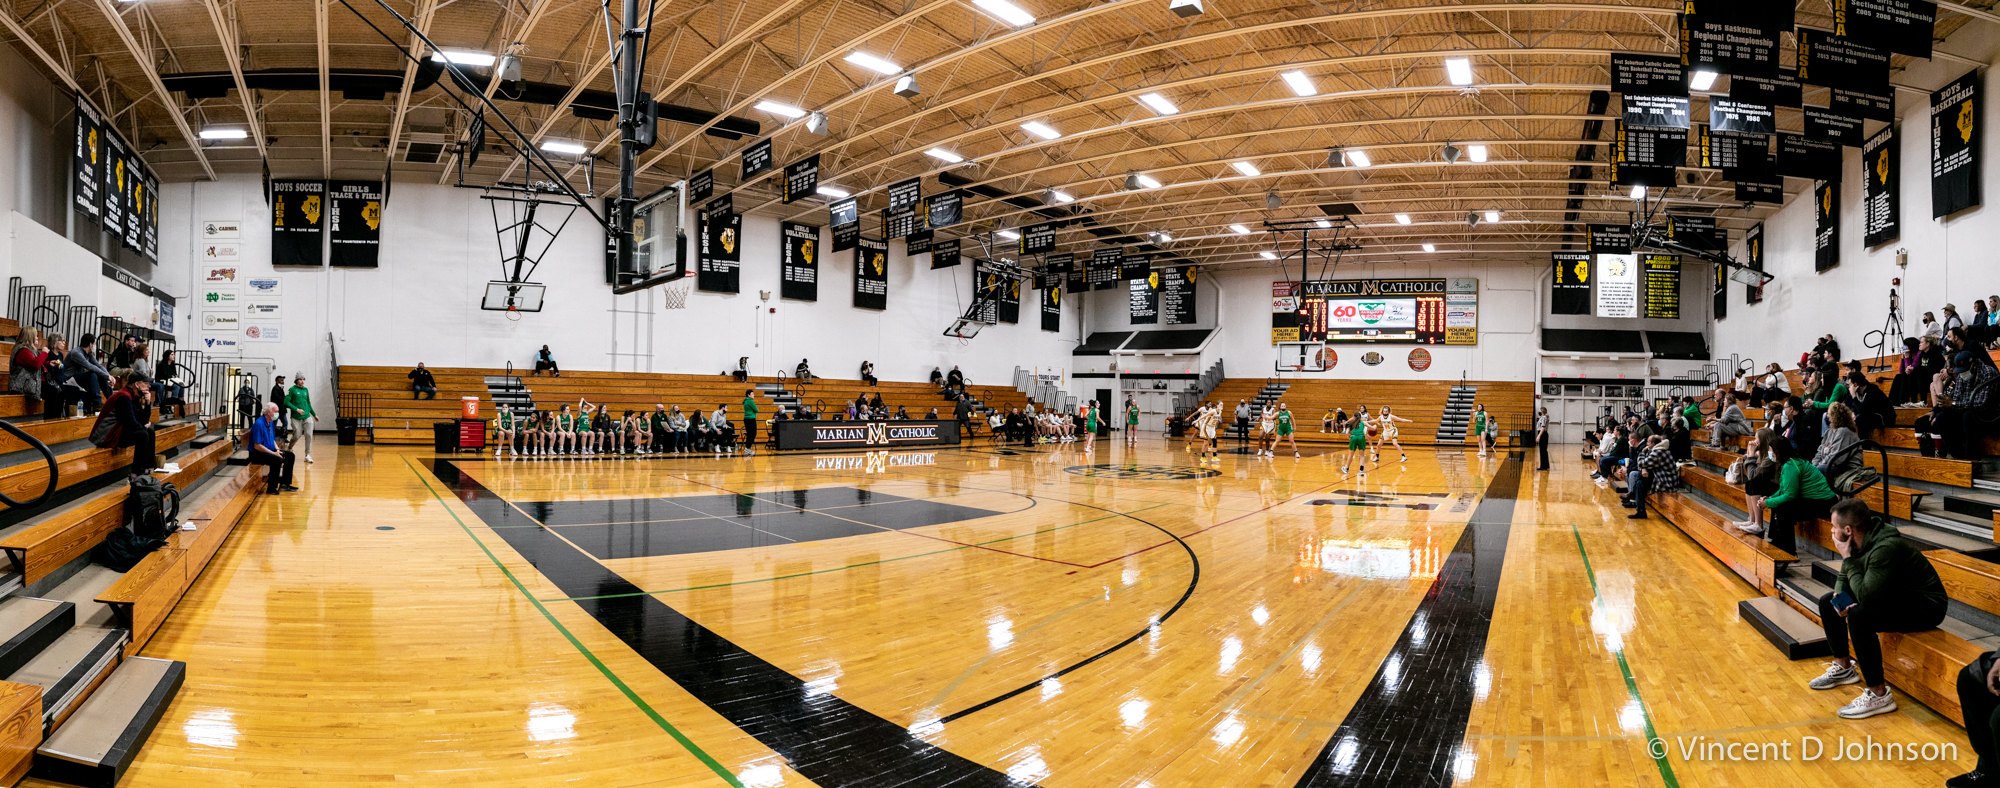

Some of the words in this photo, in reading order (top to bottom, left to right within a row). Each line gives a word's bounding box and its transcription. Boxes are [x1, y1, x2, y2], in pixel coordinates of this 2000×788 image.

[1895, 0, 1909, 9] Golf
[1851, 0, 1885, 11] Sectional
[1886, 5, 1933, 23] Championship
[1856, 8, 1872, 17] 2005
[1704, 22, 1722, 32] Boys
[1724, 24, 1762, 35] Basketball
[1680, 17, 1690, 66] IHSA
[1693, 30, 1725, 41] Regional
[1726, 34, 1774, 48] Championship
[1798, 32, 1810, 79] IHSA
[1814, 42, 1844, 54] Sectional
[1845, 48, 1887, 62] Championship
[1759, 83, 1775, 91] 1970
[1770, 79, 1801, 88] Championship
[1865, 93, 1891, 103] Championship
[1940, 82, 1961, 101] BOYS
[1835, 95, 1849, 103] 1962
[1930, 85, 1975, 116] BASKETBALL
[78, 95, 100, 127] FOOTBALL
[1627, 106, 1642, 114] 1990
[1713, 105, 1735, 113] Football
[1736, 107, 1772, 117] Championship
[1737, 102, 1767, 110] Conference
[1821, 112, 1843, 121] Metropolitan
[1843, 116, 1862, 124] Conference
[1830, 121, 1854, 129] Championship
[1828, 129, 1842, 137] 1997
[1933, 116, 1941, 162] IHSA
[1618, 121, 1626, 162] IHSA
[1701, 126, 1710, 167] IHSA
[1803, 141, 1835, 150] Championship
[1863, 128, 1892, 156] FOOTBALL
[79, 171, 91, 186] CLASS
[83, 185, 94, 200] STATE
[274, 182, 294, 192] BOYS
[295, 182, 323, 193] SOCCER
[342, 185, 370, 193] GIRLS
[330, 191, 354, 199] TRACK
[108, 210, 120, 224] STATE
[274, 194, 285, 227] IHSA
[331, 199, 340, 232] IHSA
[369, 208, 379, 217] M
[785, 229, 818, 241] VOLLEYBALL
[794, 225, 810, 233] GIRLS
[702, 225, 710, 254] IHSA
[858, 238, 888, 250] SOFTBALL
[785, 237, 793, 264] IHSA
[1556, 261, 1564, 283] IHSA
[1305, 282, 1357, 294] MARIAN
[1360, 280, 1381, 296] M
[1380, 281, 1444, 293] CATHOLIC
[1333, 305, 1357, 318] 60
[816, 428, 864, 440] MARIAN
[866, 422, 889, 445] M
[890, 427, 936, 438] CATHOLIC
